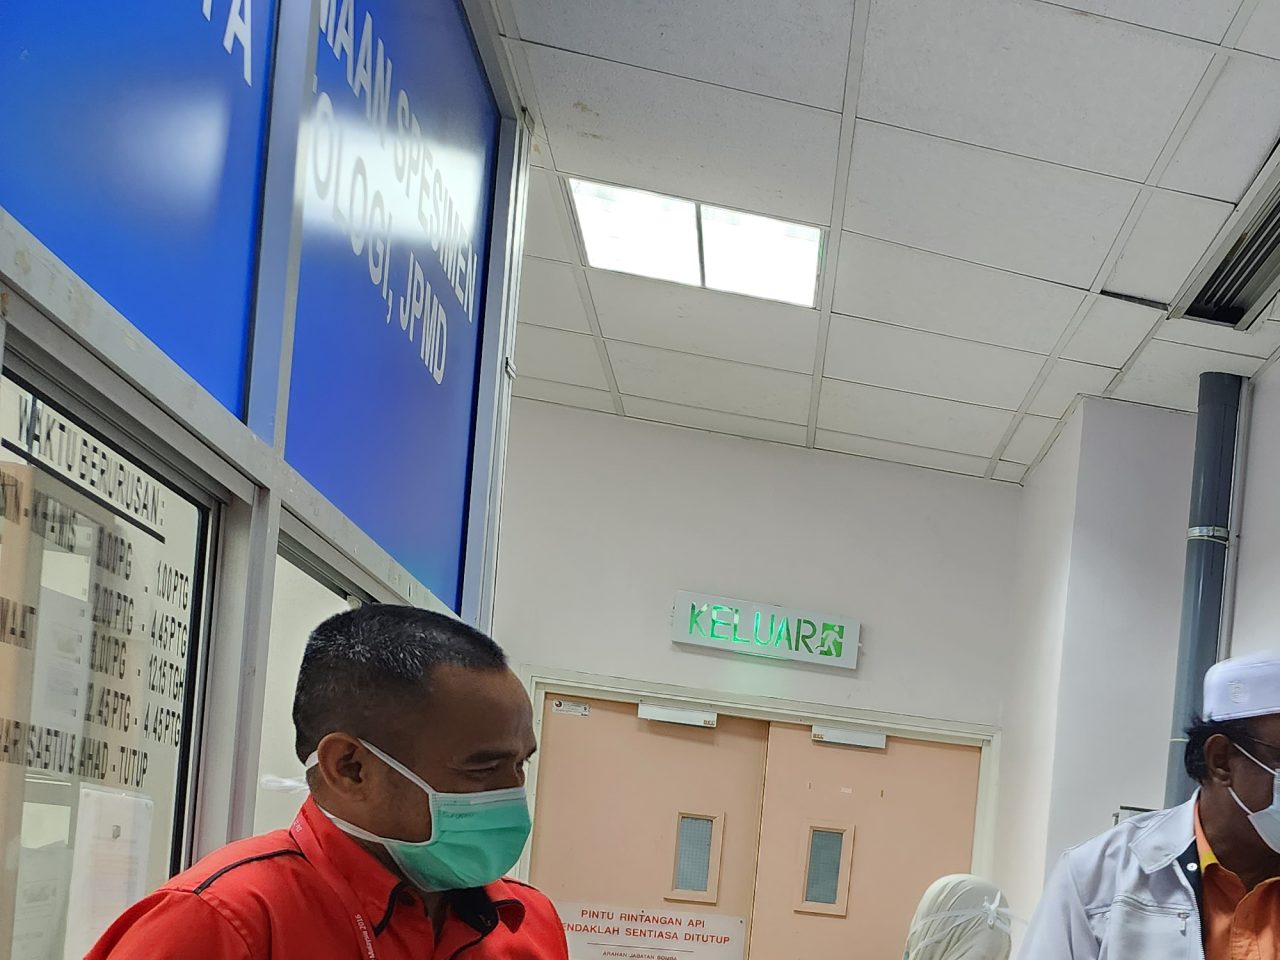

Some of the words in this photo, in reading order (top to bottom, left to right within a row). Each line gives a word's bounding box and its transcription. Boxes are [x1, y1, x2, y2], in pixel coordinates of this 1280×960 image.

[394, 89, 478, 323] SPESIMEN
[400, 250, 447, 385] JPMD
[688, 602, 817, 655] KELUAR
[119, 745, 148, 788] TUTUP
[355, 913, 367, 929] 2016
[581, 909, 614, 920] PINTU
[620, 913, 682, 926] RINTANGAN
[687, 919, 705, 928] API
[625, 928, 678, 940] SENTIASA
[684, 933, 730, 945] DITUTUP
